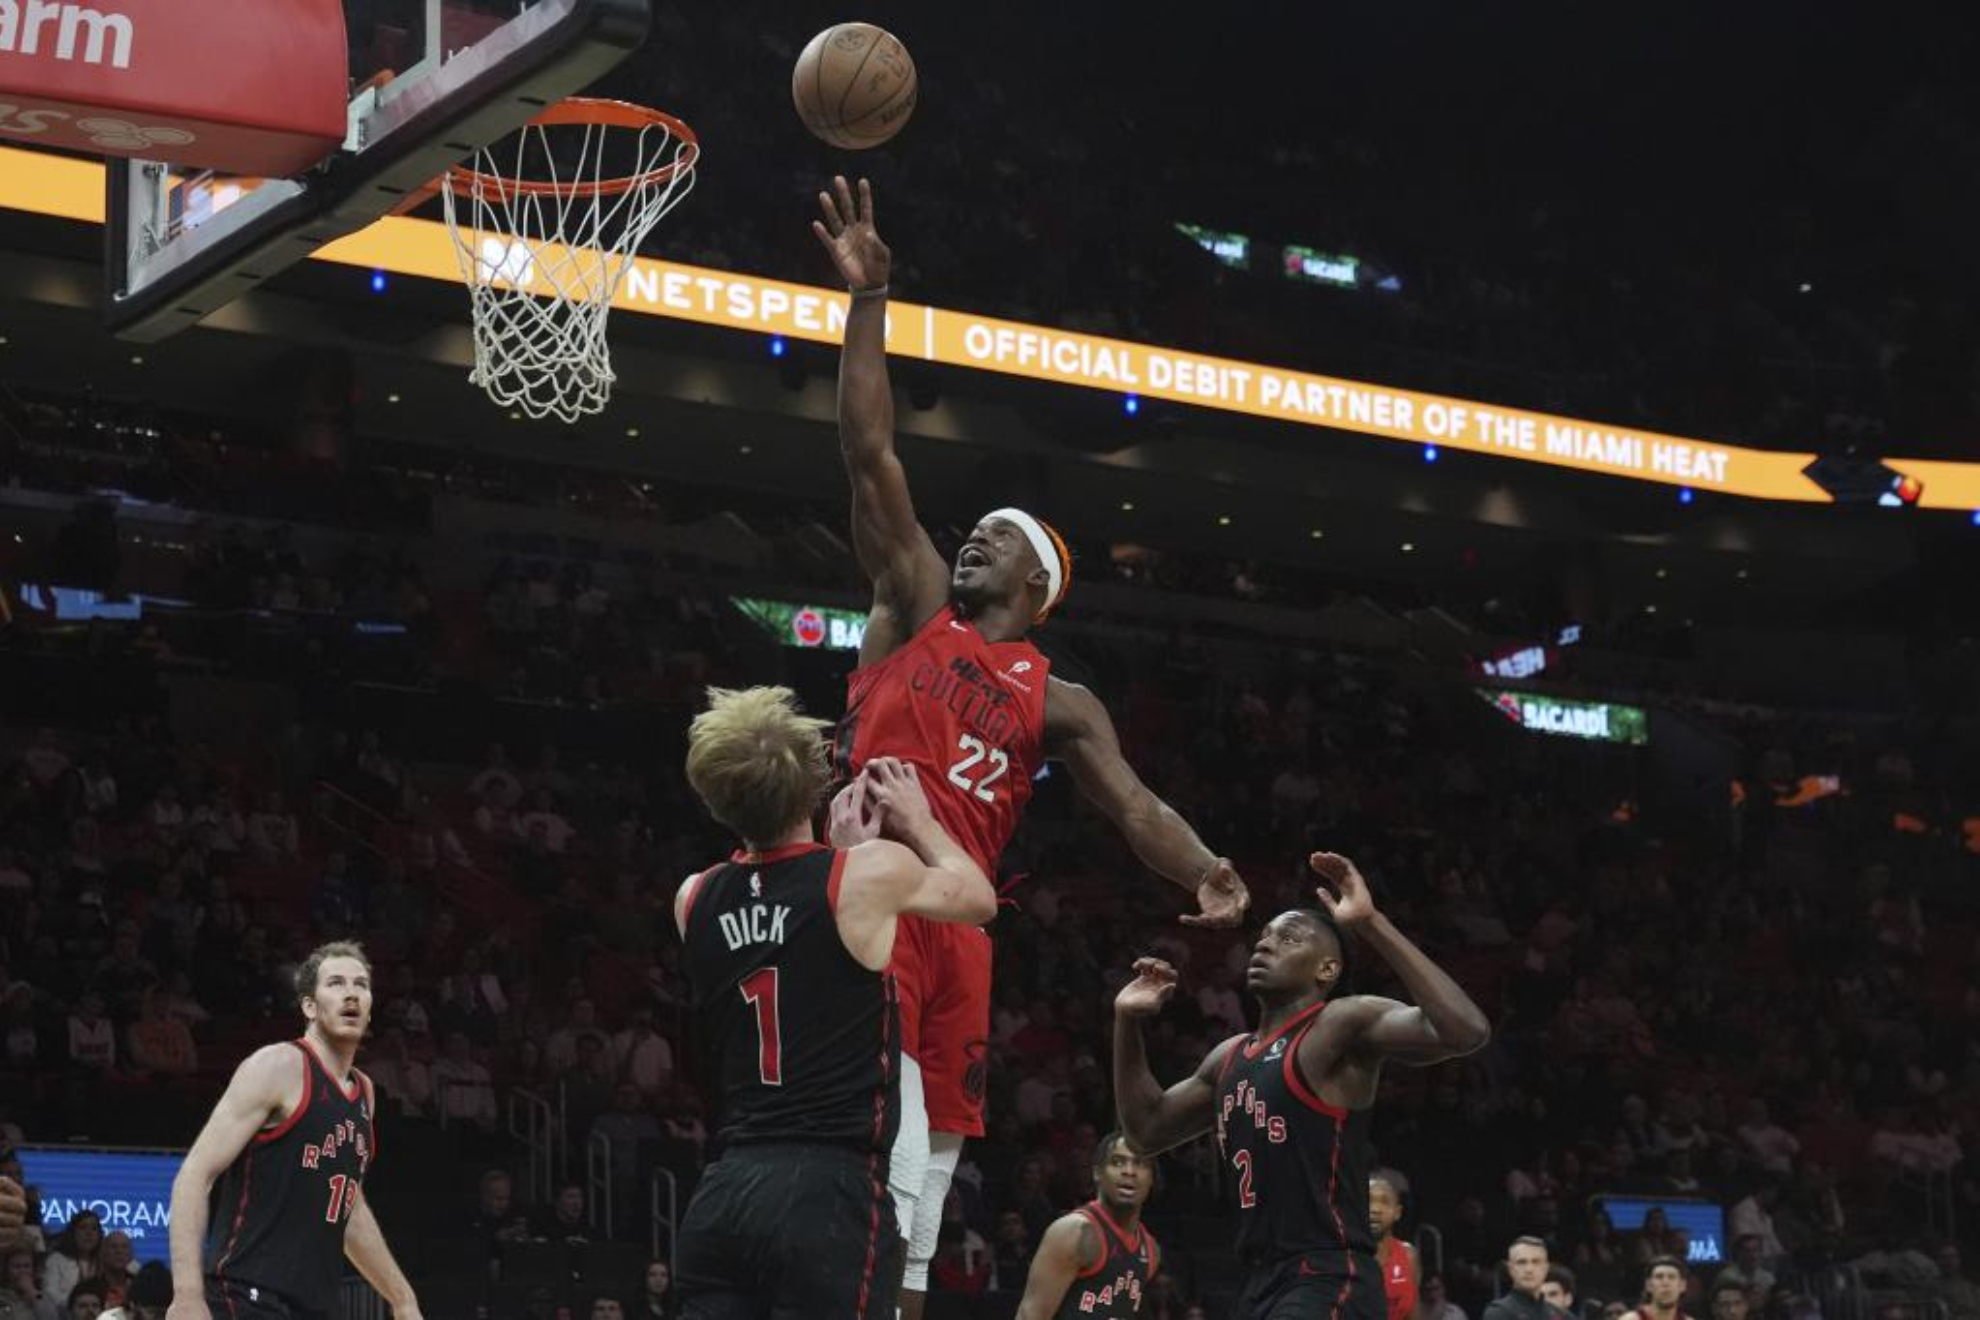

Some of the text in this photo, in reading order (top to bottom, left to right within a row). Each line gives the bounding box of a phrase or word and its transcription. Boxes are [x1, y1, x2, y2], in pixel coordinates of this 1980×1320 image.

[627, 266, 1729, 483] NETSPEN OFFICIAL DEBIT PARTNER OF THE MIAMI HEAT
[947, 733, 1009, 803] 22
[718, 903, 792, 951] DICK
[738, 966, 783, 1087] 1
[1231, 1148, 1257, 1209] 2
